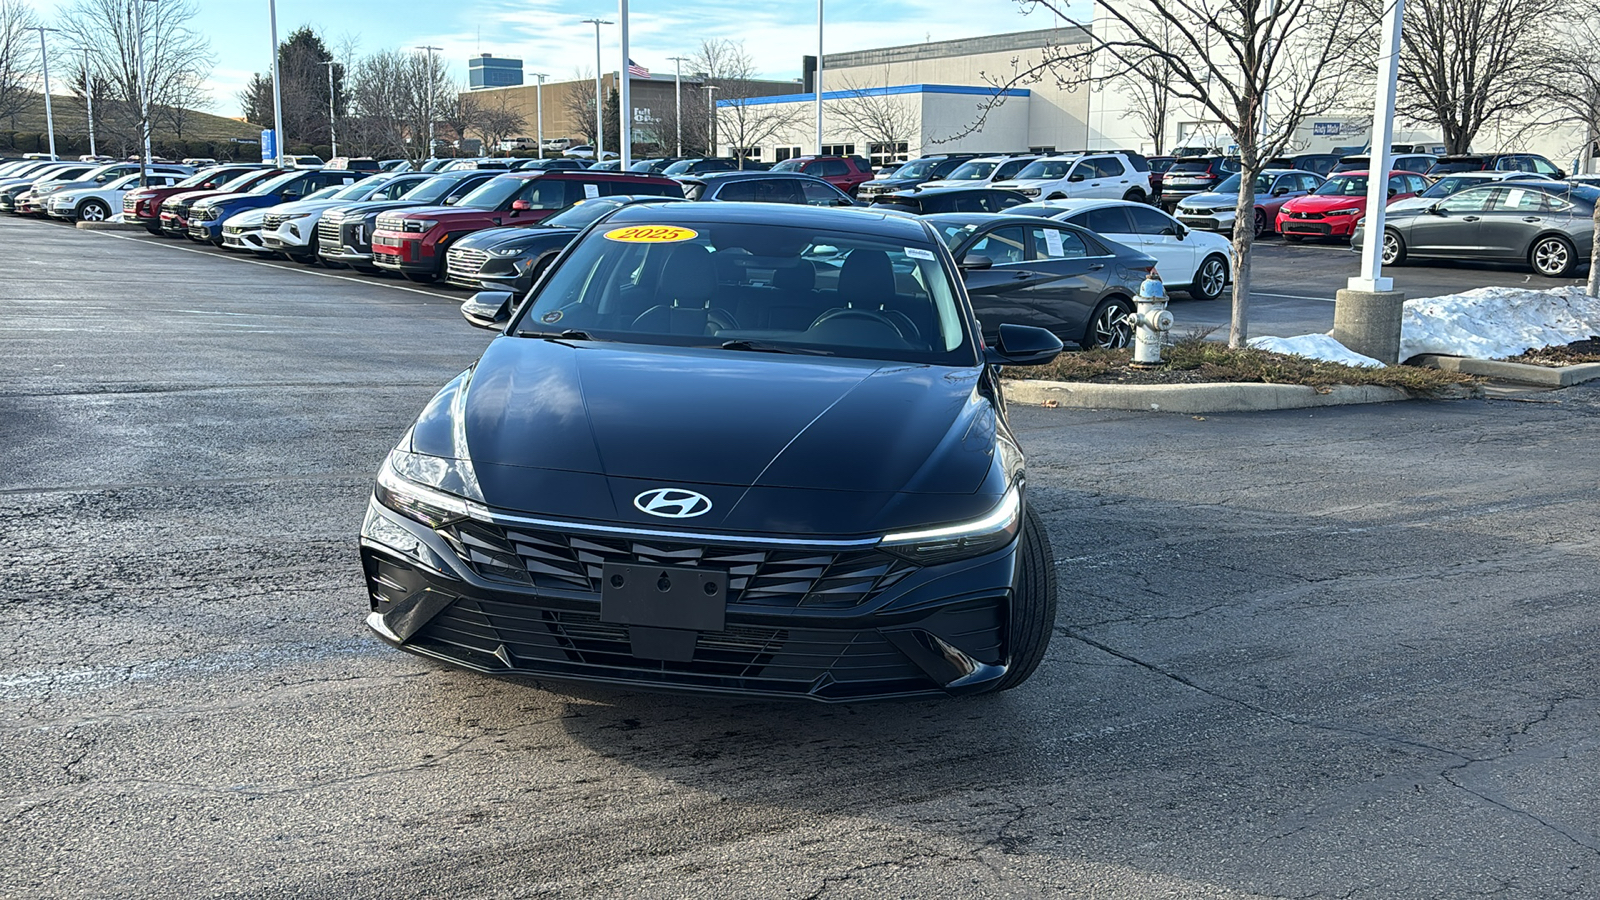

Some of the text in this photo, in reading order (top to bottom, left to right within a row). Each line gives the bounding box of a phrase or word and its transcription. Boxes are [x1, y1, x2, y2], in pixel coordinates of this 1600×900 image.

[633, 107, 651, 116] Full
[1314, 124, 1327, 135] Andy
[616, 228, 685, 240] 2025
